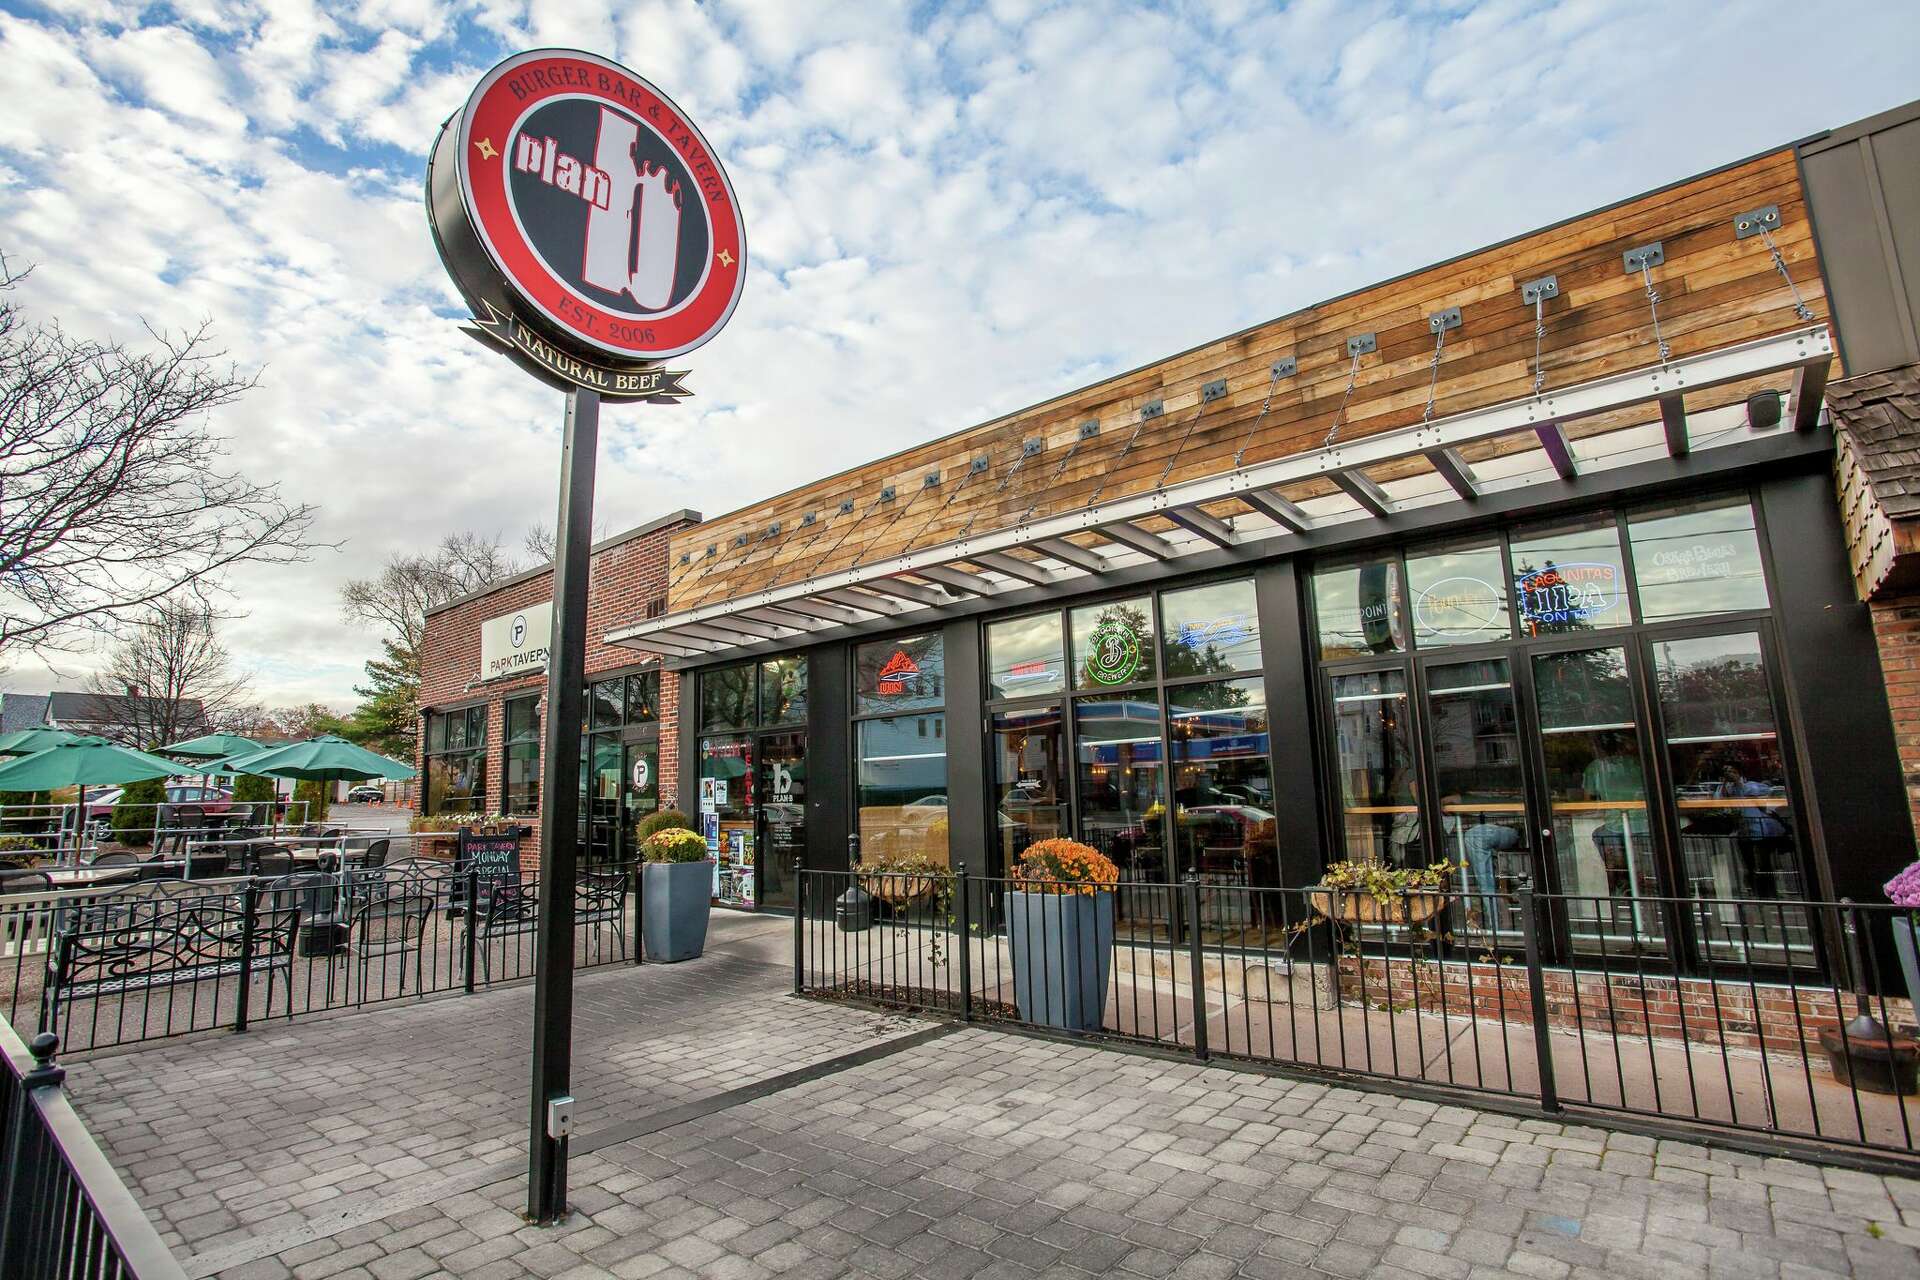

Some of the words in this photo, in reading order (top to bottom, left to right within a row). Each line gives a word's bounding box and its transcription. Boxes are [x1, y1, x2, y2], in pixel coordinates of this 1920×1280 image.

[508, 66, 592, 101] BURGER
[598, 73, 643, 107] BAR
[647, 104, 661, 120] &
[667, 118, 725, 203] TAVERN
[558, 296, 599, 333] EST.
[608, 323, 656, 344] 2006
[518, 324, 609, 387] NATURAL
[616, 373, 661, 390] BEEF
[1523, 567, 1613, 593] LAGUNITAS
[1543, 612, 1567, 622] ON
[514, 625, 523, 641] P
[471, 850, 511, 865] MONDAY
